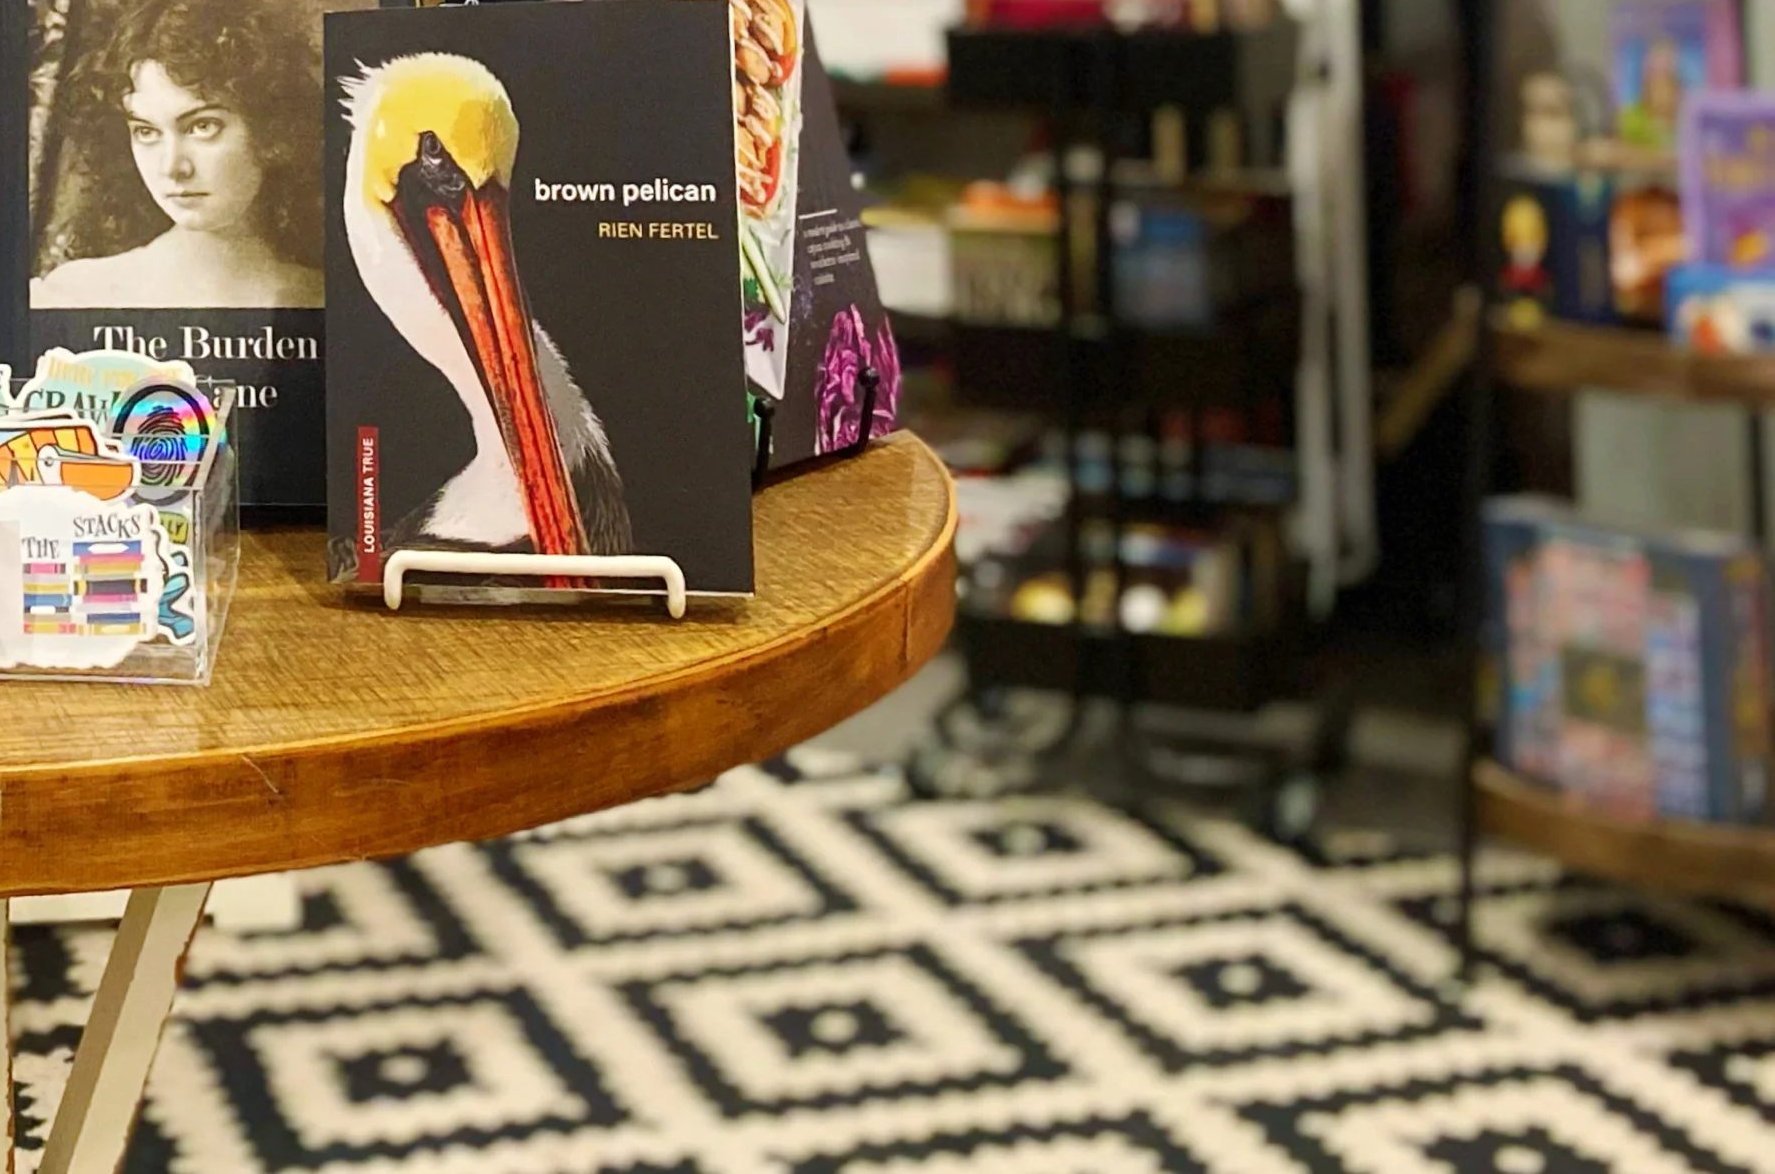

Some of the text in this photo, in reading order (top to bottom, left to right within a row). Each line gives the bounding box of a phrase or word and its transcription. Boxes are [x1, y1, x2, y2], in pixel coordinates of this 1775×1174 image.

[534, 178, 717, 207] brown pelican
[598, 222, 719, 240] RIEN FERTEL
[94, 325, 319, 360] The Burden
[362, 437, 376, 554] LOUISIANA TRUE
[22, 512, 142, 560] THE STACKS
